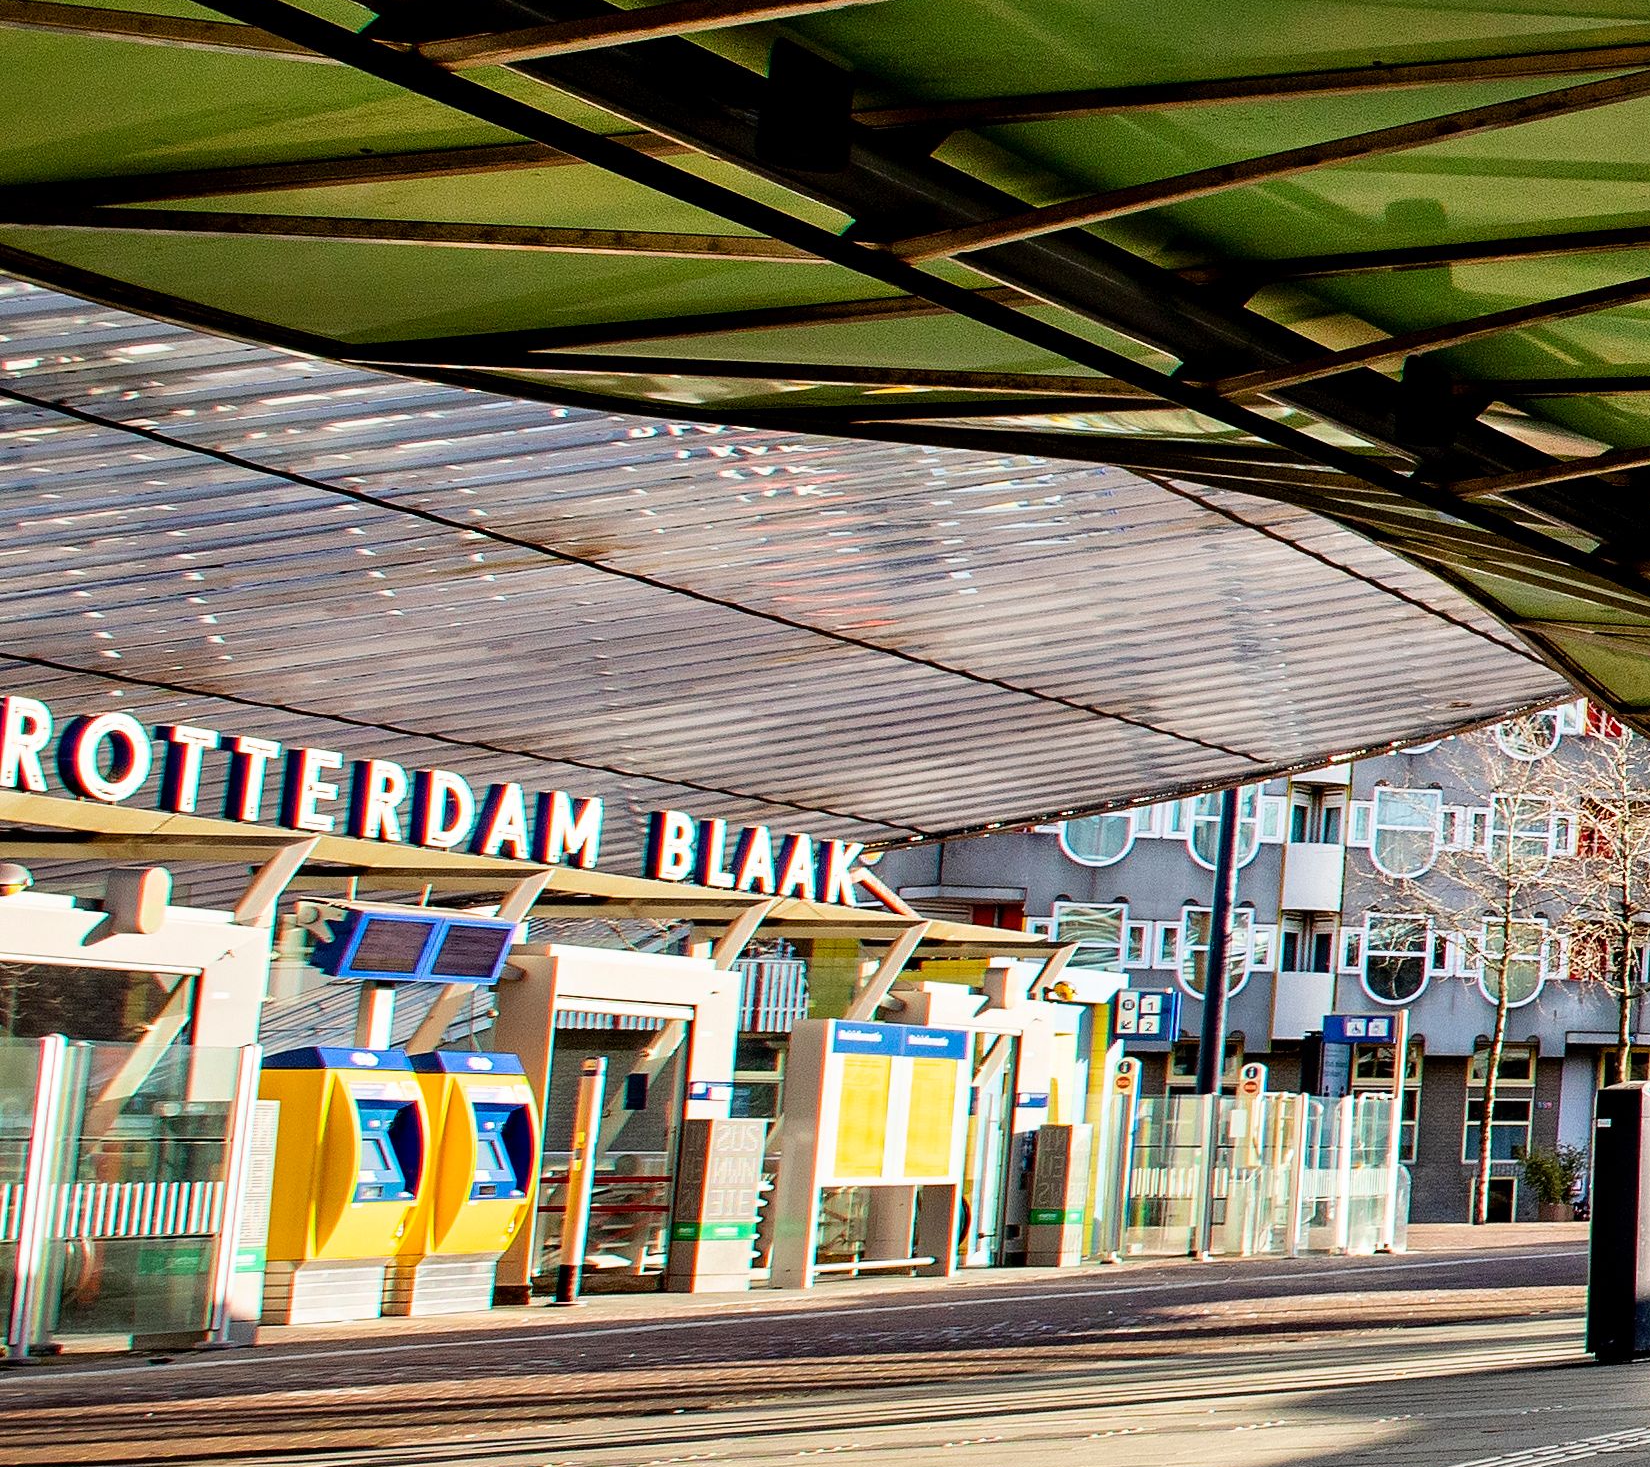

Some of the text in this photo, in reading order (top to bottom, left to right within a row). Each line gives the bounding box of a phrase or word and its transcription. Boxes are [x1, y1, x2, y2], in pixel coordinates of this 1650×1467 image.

[0, 694, 865, 907] ROTTERDAM BLAAK
[1144, 1021, 1154, 1032] 2
